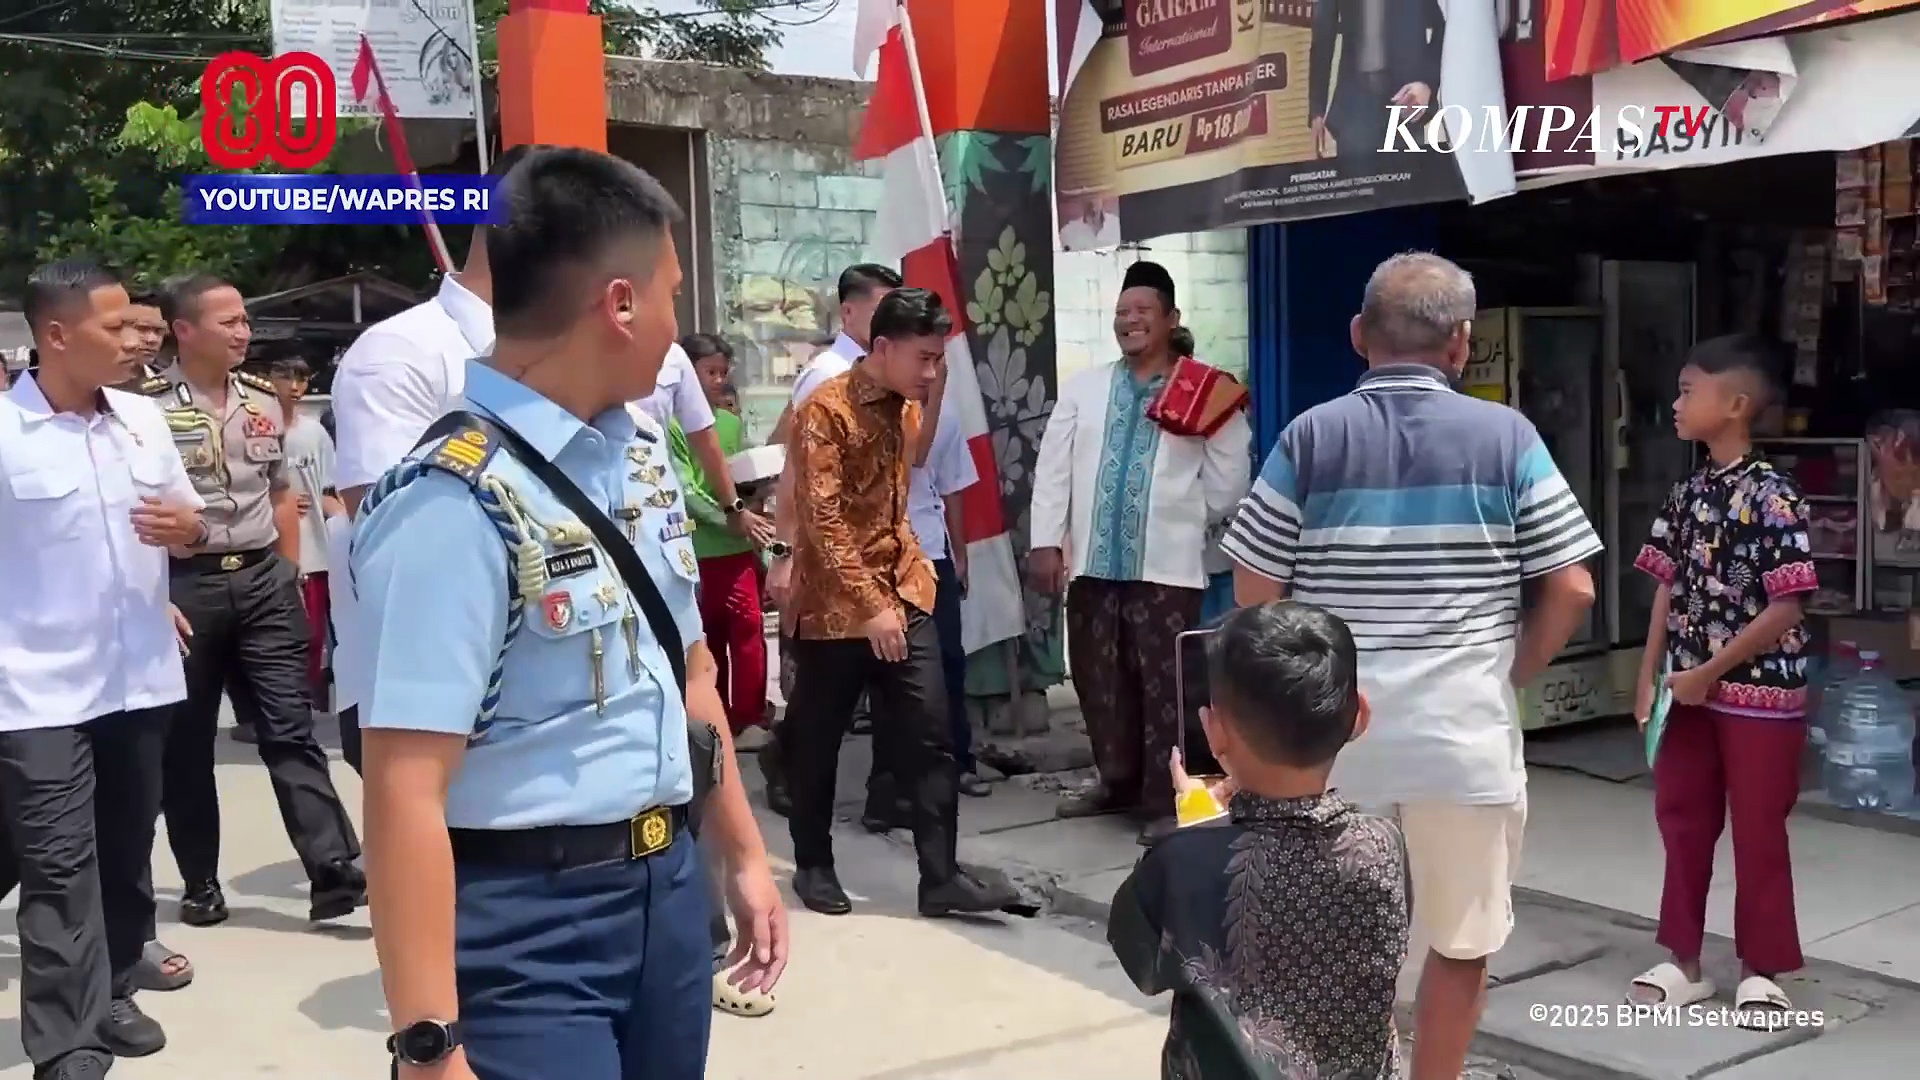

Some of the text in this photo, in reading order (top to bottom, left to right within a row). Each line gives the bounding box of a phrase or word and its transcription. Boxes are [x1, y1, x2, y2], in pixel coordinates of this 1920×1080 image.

[1136, 0, 1217, 28] GARA
[1139, 16, 1219, 55] International
[1107, 106, 1135, 121] RASA
[1135, 85, 1203, 114] LEGENDARIS
[1205, 75, 1244, 97] TANPA
[1122, 123, 1184, 157] BARU
[1617, 113, 1744, 160] HASYI
